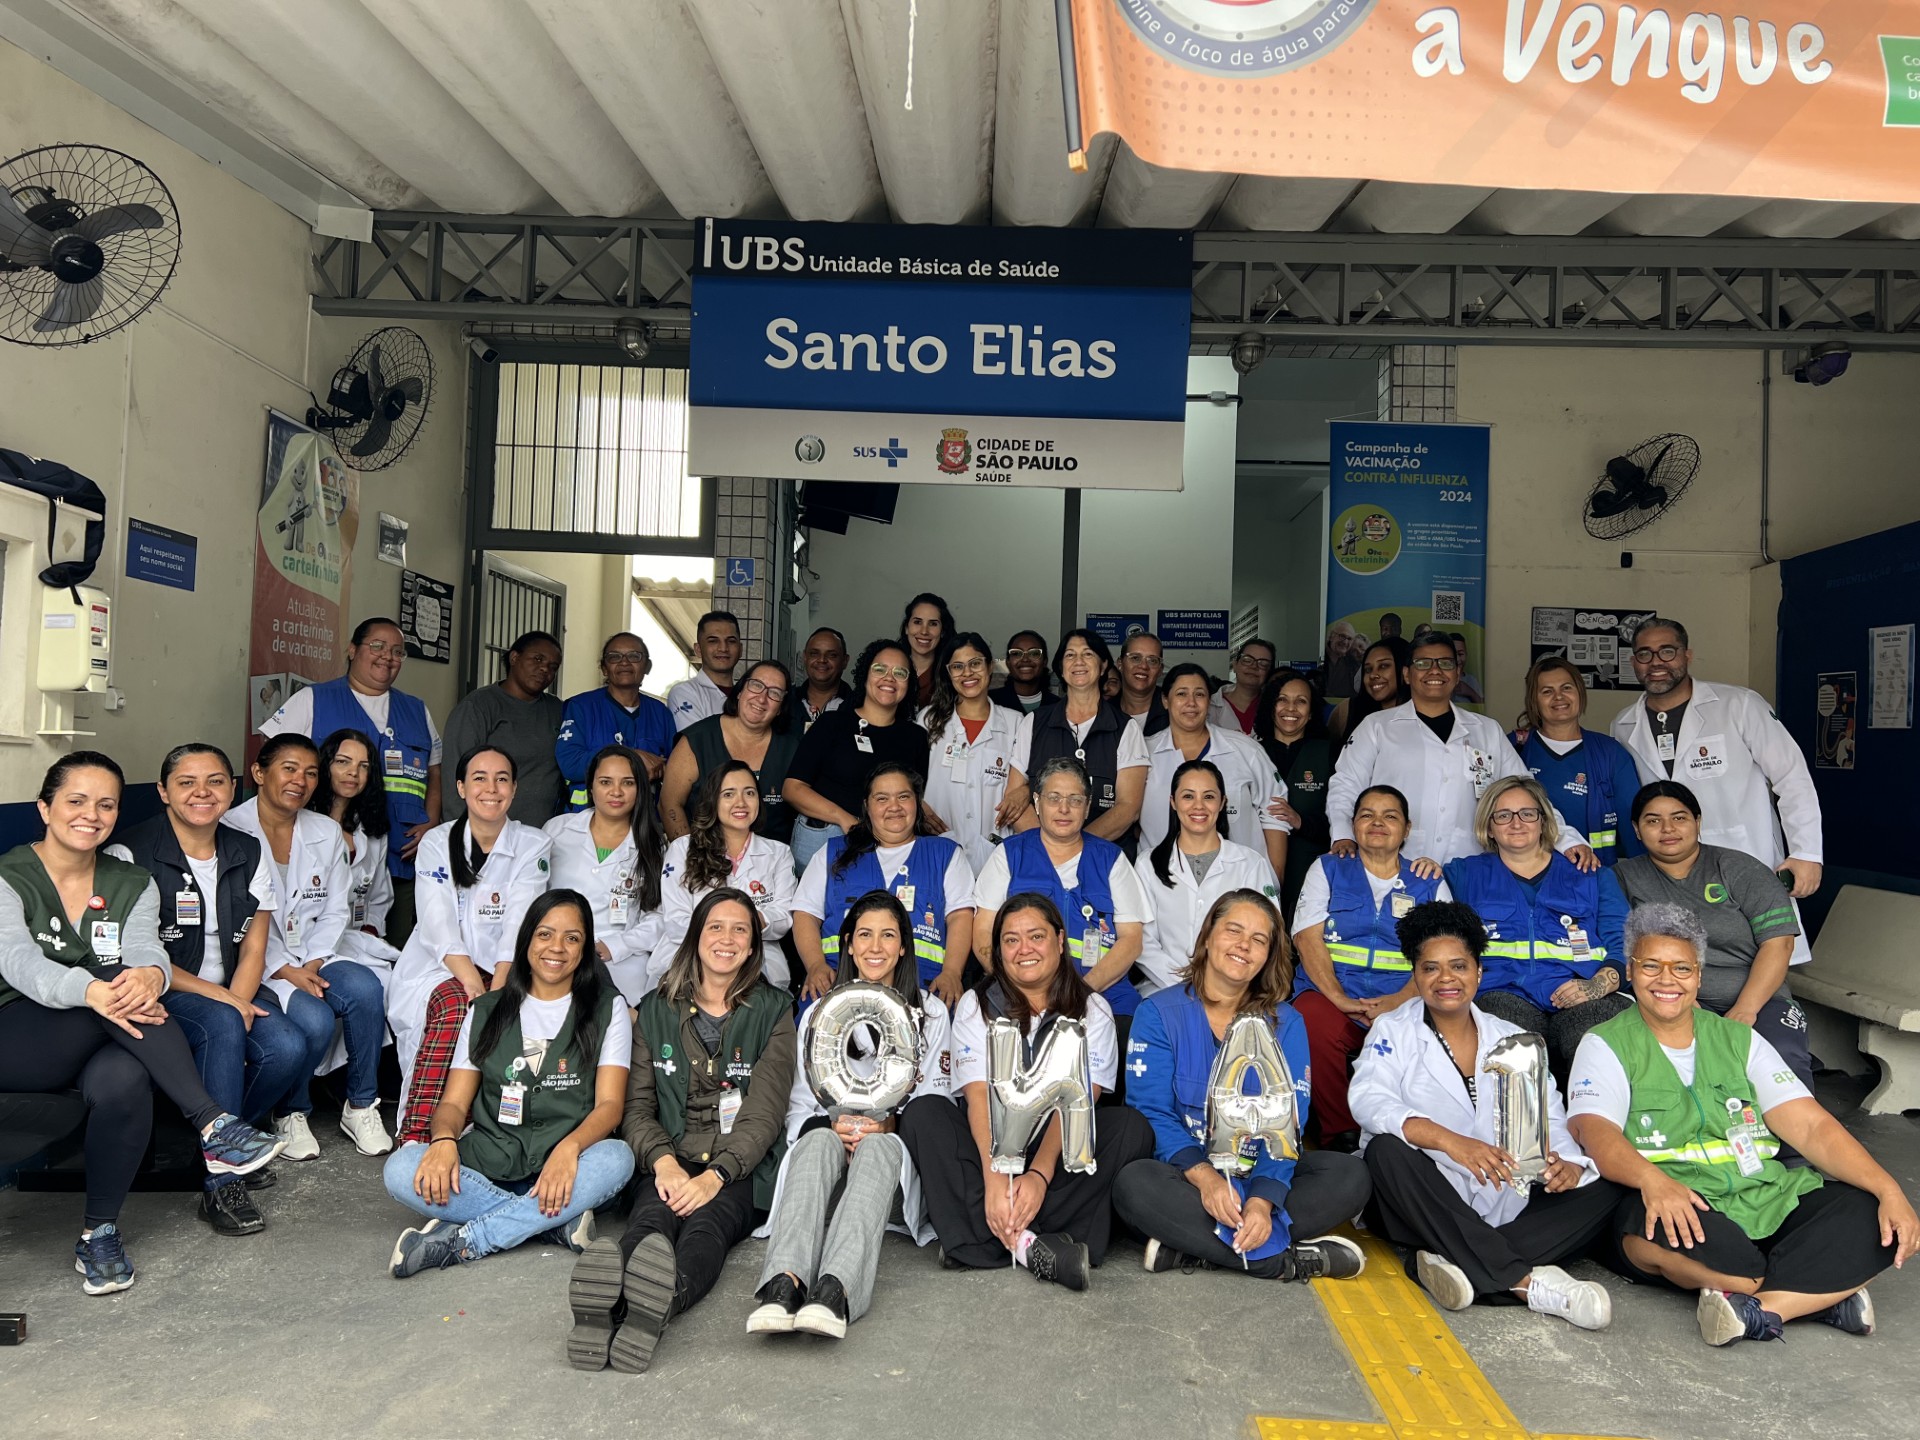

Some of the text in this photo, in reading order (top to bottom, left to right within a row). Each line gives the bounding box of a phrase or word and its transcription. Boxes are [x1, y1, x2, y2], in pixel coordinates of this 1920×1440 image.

[1164, 31, 1176, 45] o
[1181, 38, 1222, 64] foco
[1230, 50, 1254, 66] de
[1262, 39, 1309, 64] água
[1411, 7, 1466, 78] a
[720, 235, 1060, 278] UBS Unidade Básica de Saúde
[764, 317, 1117, 379] Santo Elias
[977, 438, 1054, 452] CIDADE DE
[1345, 441, 1429, 455] Campanha de
[853, 447, 877, 458] SUS
[976, 452, 1078, 471] SÃO PAULO
[1345, 455, 1421, 471] VACINAÇÃO
[975, 471, 1011, 483] SAÚDE
[1344, 472, 1469, 486] CONTRA INFLUENZA
[1439, 490, 1472, 503] 2024
[140, 544, 186, 562] Aqui respeitamos
[150, 558, 166, 567] nome
[287, 598, 326, 620] Atualize
[272, 618, 334, 643] a carteirinha
[272, 637, 332, 664] de vacinação
[37, 932, 52, 942] SUS
[925, 931, 941, 941] PAULO
[557, 1079, 581, 1087] PAULO
[1635, 1136, 1649, 1144] SUS
